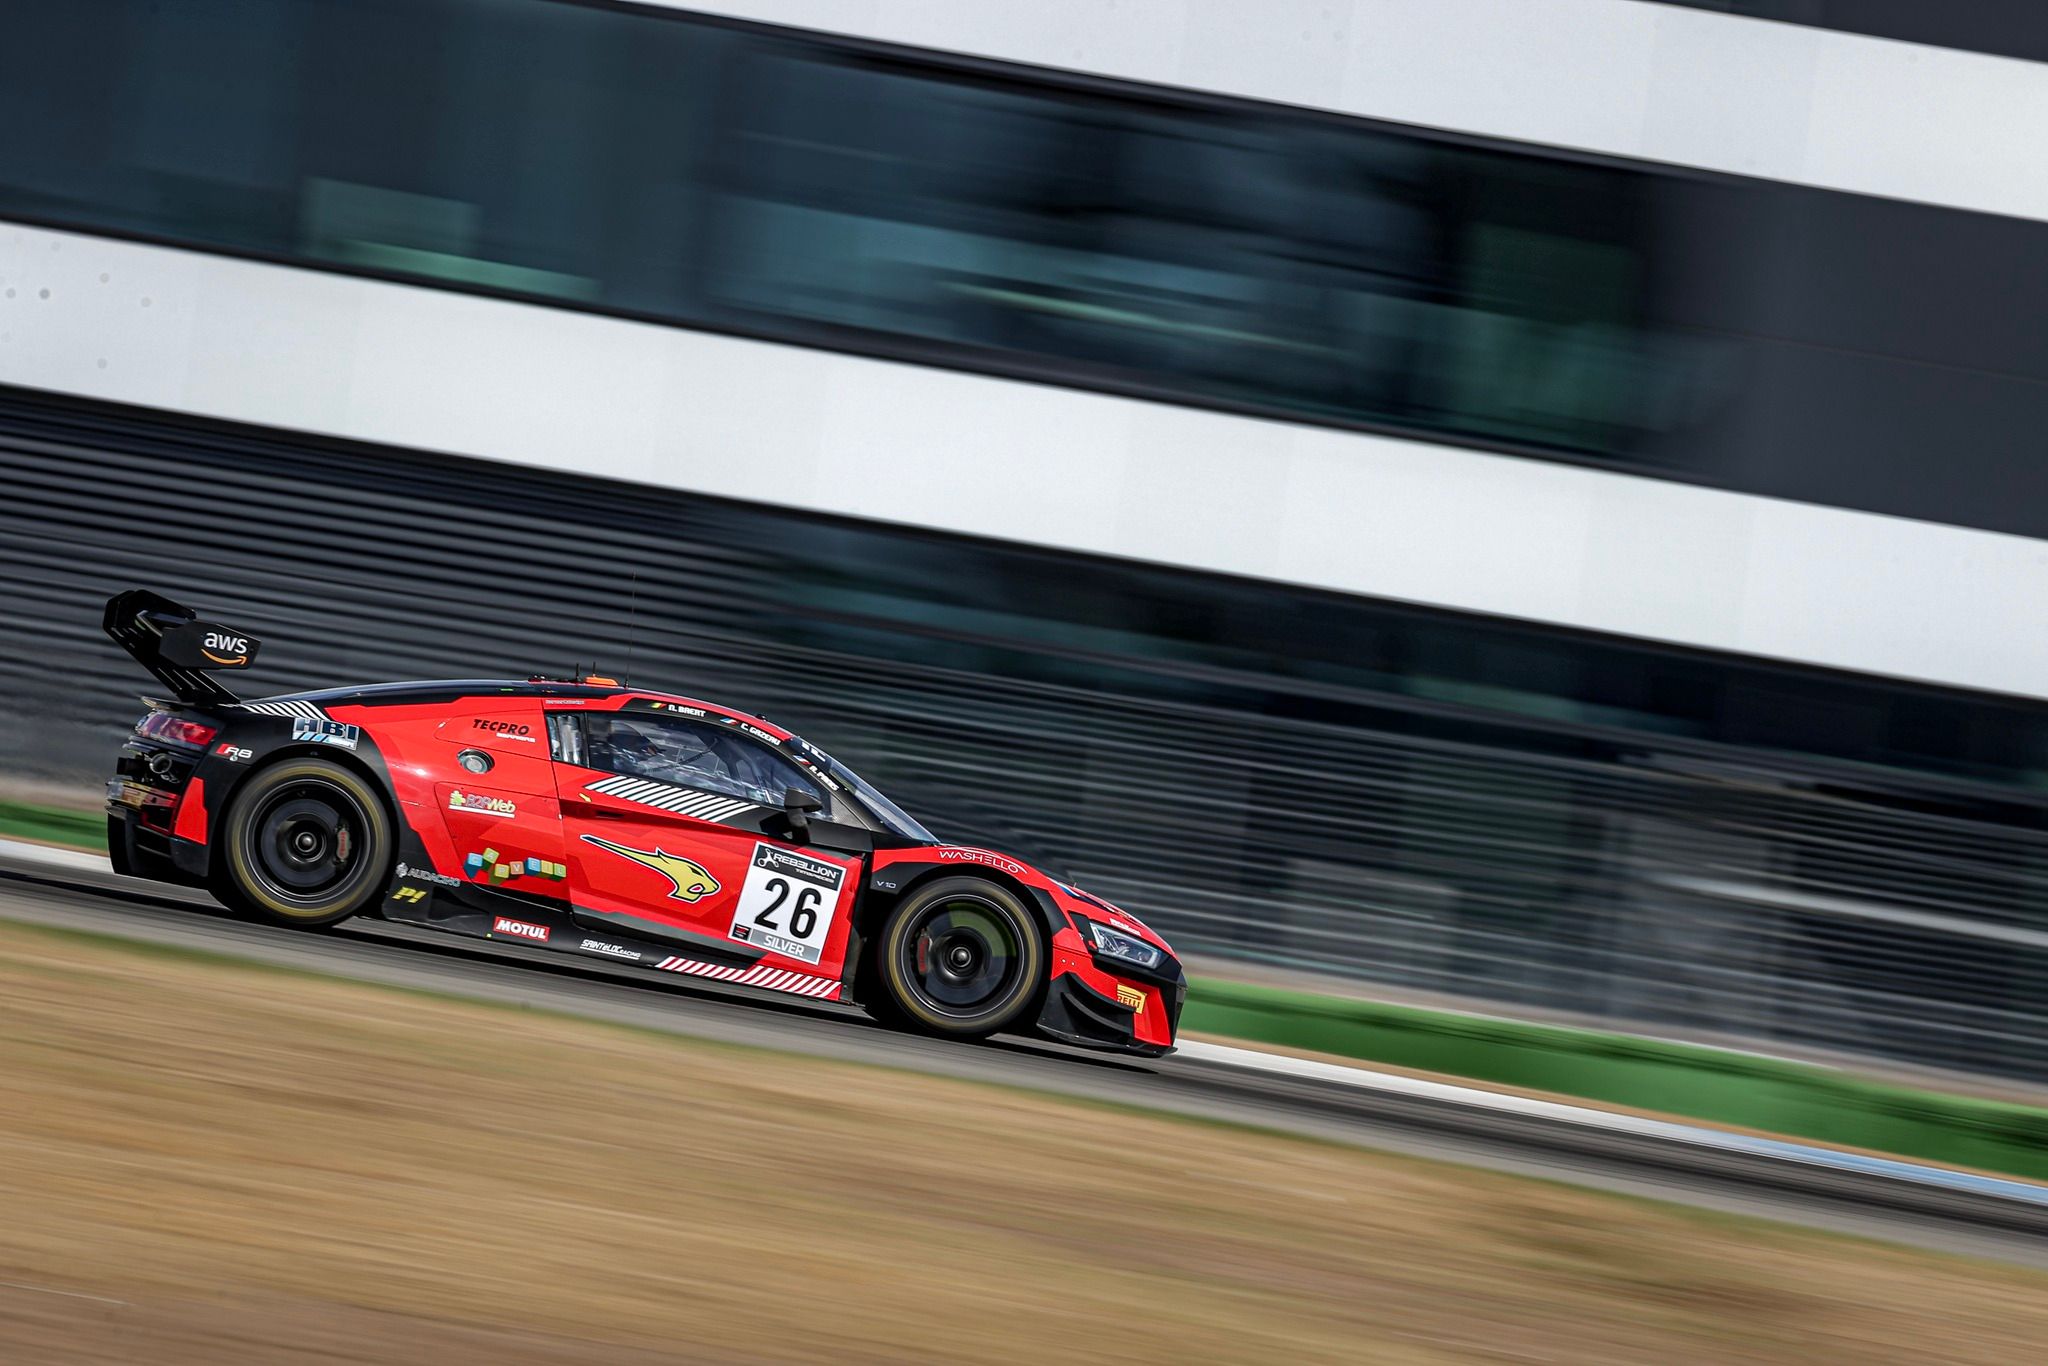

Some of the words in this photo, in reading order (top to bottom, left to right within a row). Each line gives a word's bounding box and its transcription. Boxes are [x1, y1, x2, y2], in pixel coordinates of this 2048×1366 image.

[203, 631, 248, 654] aws
[293, 717, 360, 742] HBI
[472, 718, 530, 736] TECPRO
[773, 853, 837, 879] REBELLION
[939, 850, 1019, 874] WASHELLO
[753, 877, 823, 940] 26
[496, 919, 546, 941] MOTUL
[763, 934, 806, 958] SILVER
